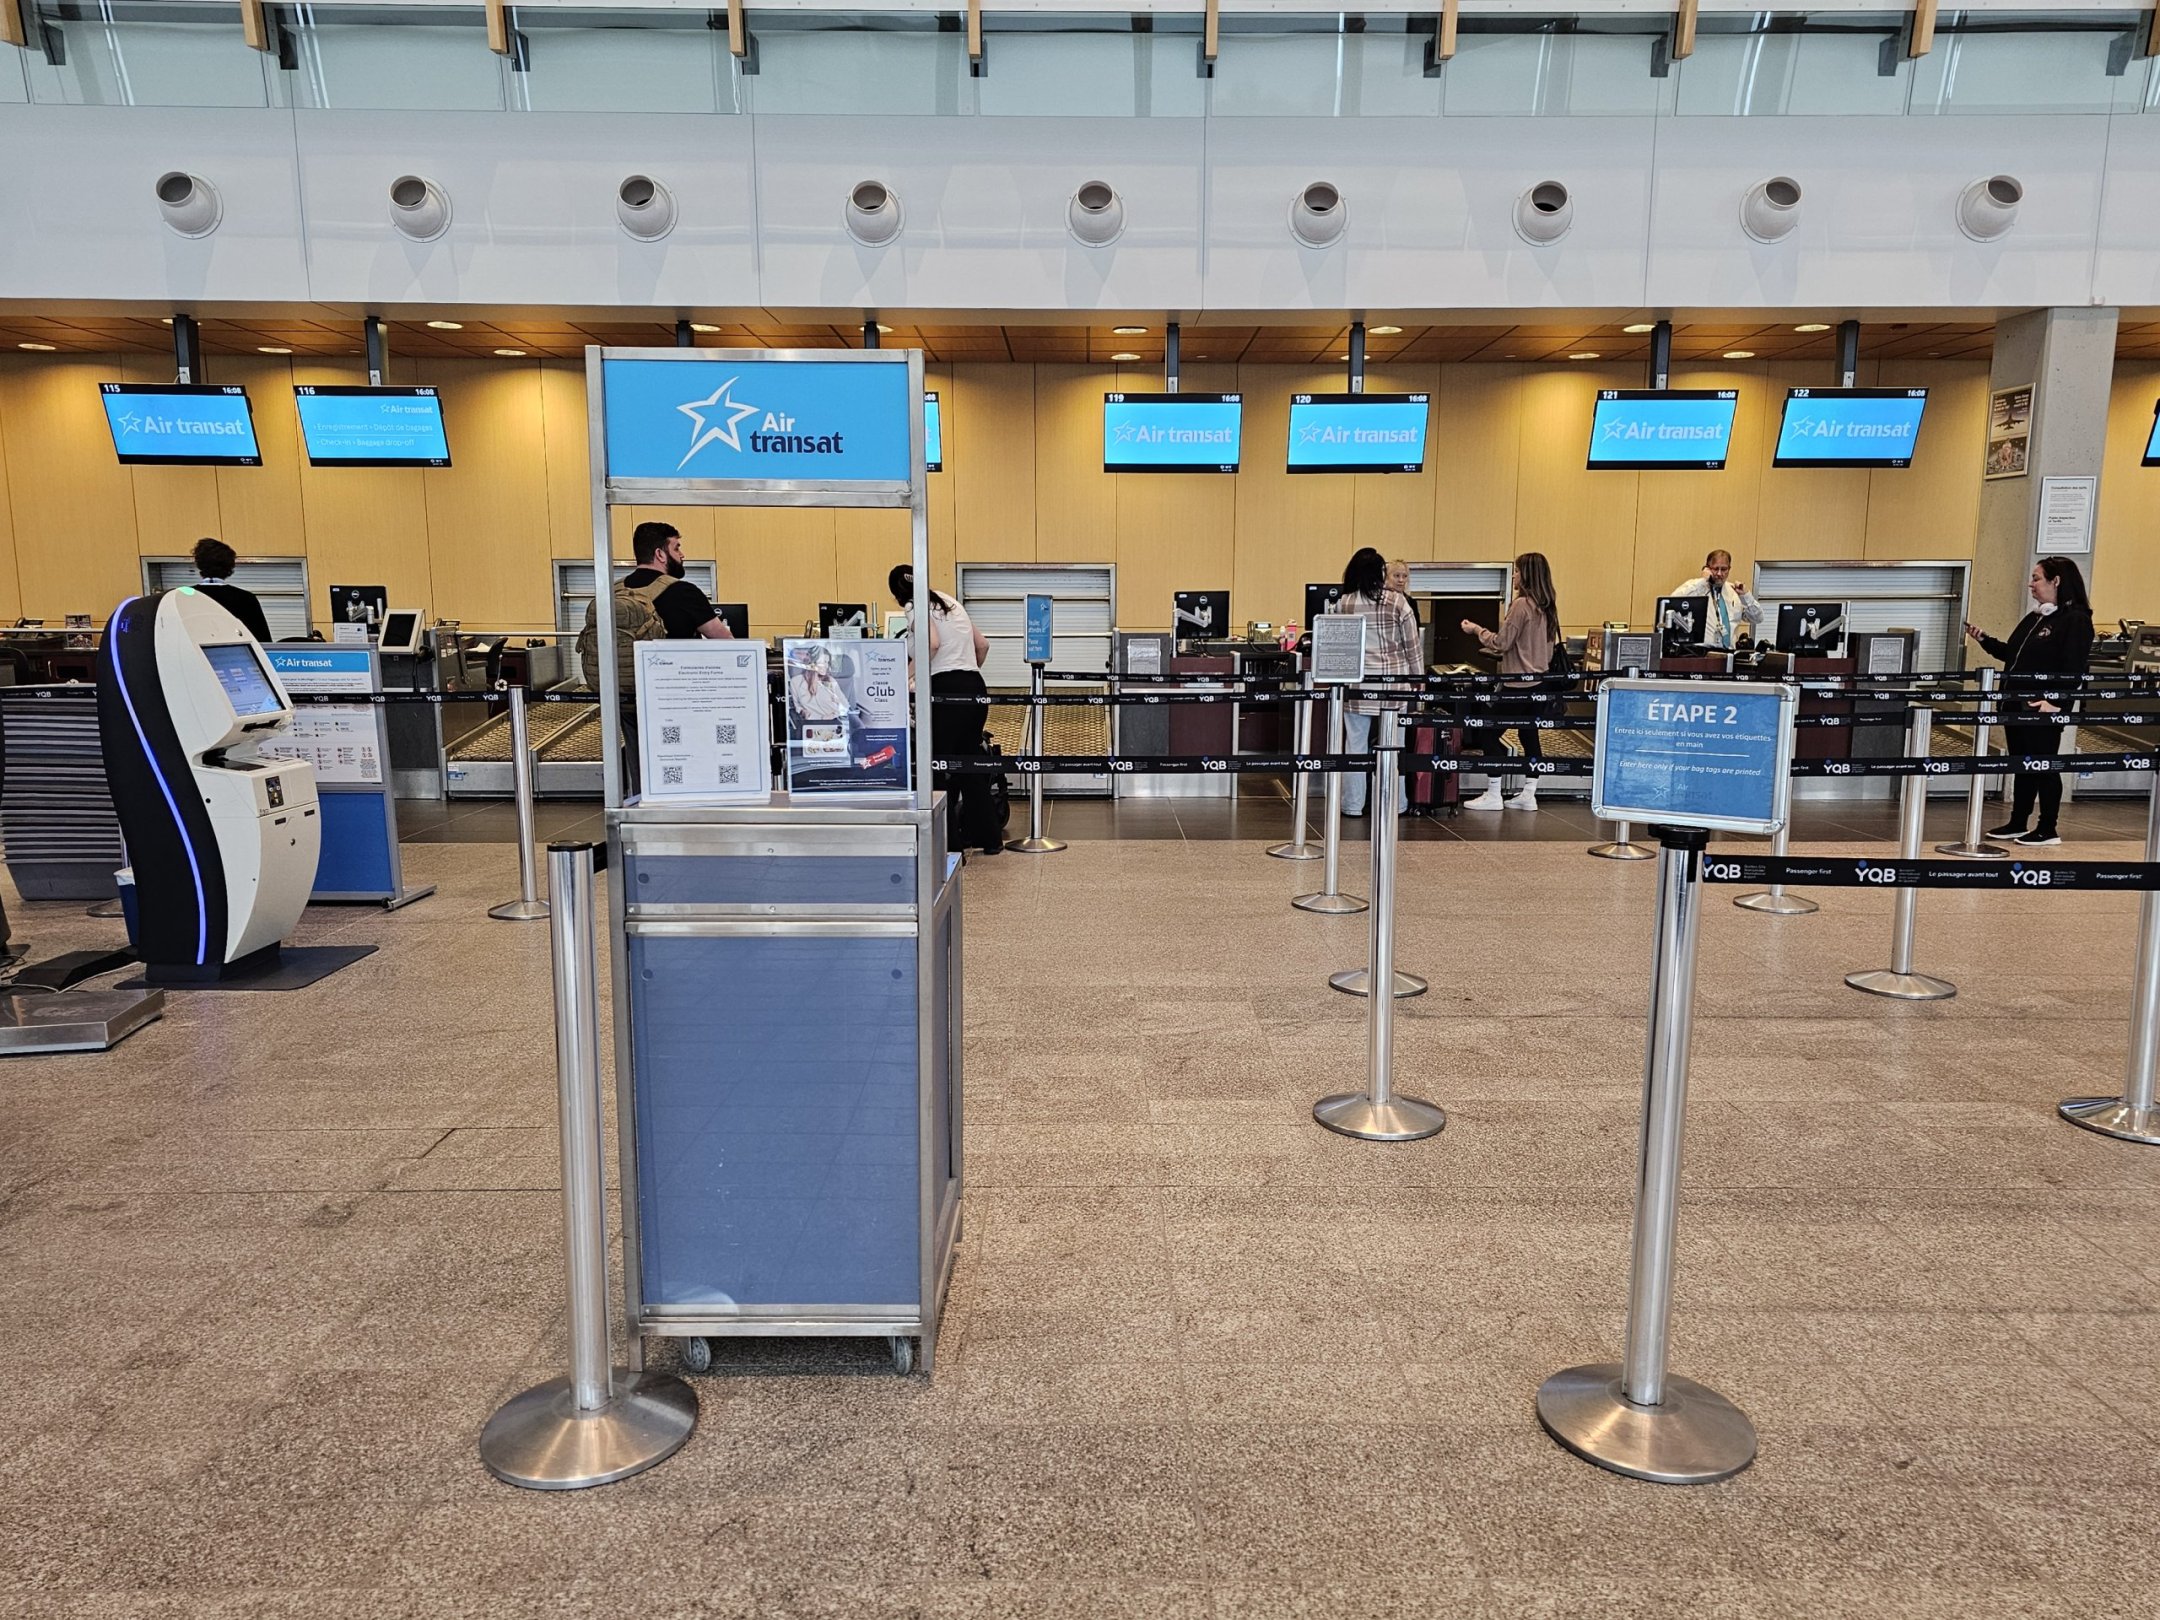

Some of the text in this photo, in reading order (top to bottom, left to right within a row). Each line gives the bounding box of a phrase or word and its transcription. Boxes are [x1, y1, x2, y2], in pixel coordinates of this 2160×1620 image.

[104, 384, 120, 393] 115
[299, 387, 315, 395] 116
[1108, 394, 1124, 402] 119
[1602, 391, 1618, 400] 121
[1793, 389, 1809, 398] 122
[1295, 395, 1311, 404] 120
[144, 416, 245, 435] Air transat
[761, 412, 795, 432] Air
[1625, 421, 1723, 440] Air transat
[1813, 419, 1911, 438] Air transat
[1136, 426, 1232, 444] Air transat
[1321, 426, 1418, 444] Air transat
[750, 430, 844, 454] transat
[286, 658, 332, 667] Air transat
[866, 686, 895, 696] Club
[1648, 698, 1737, 724] ÉTAPE 2
[1464, 719, 1483, 727] YQB
[1535, 720, 1554, 728] YQB
[932, 760, 948, 770] QB
[1016, 762, 1040, 771] YQB
[1108, 761, 1133, 771] YQB
[1202, 761, 1226, 770] YQB
[1296, 760, 1321, 770] YQB
[1432, 760, 1457, 770] YQB
[1529, 763, 1555, 772] YQB
[1824, 764, 1850, 773] YQB
[1923, 763, 1949, 772] YQB
[2023, 761, 2049, 770] YQB
[2123, 759, 2150, 769] YQB
[1691, 765, 1705, 773] bag
[1706, 766, 1720, 774] tags
[1703, 864, 1741, 879] YQB
[1785, 867, 1818, 876] Passenger
[1855, 868, 1896, 883] YQB
[2010, 870, 2051, 885] YQB
